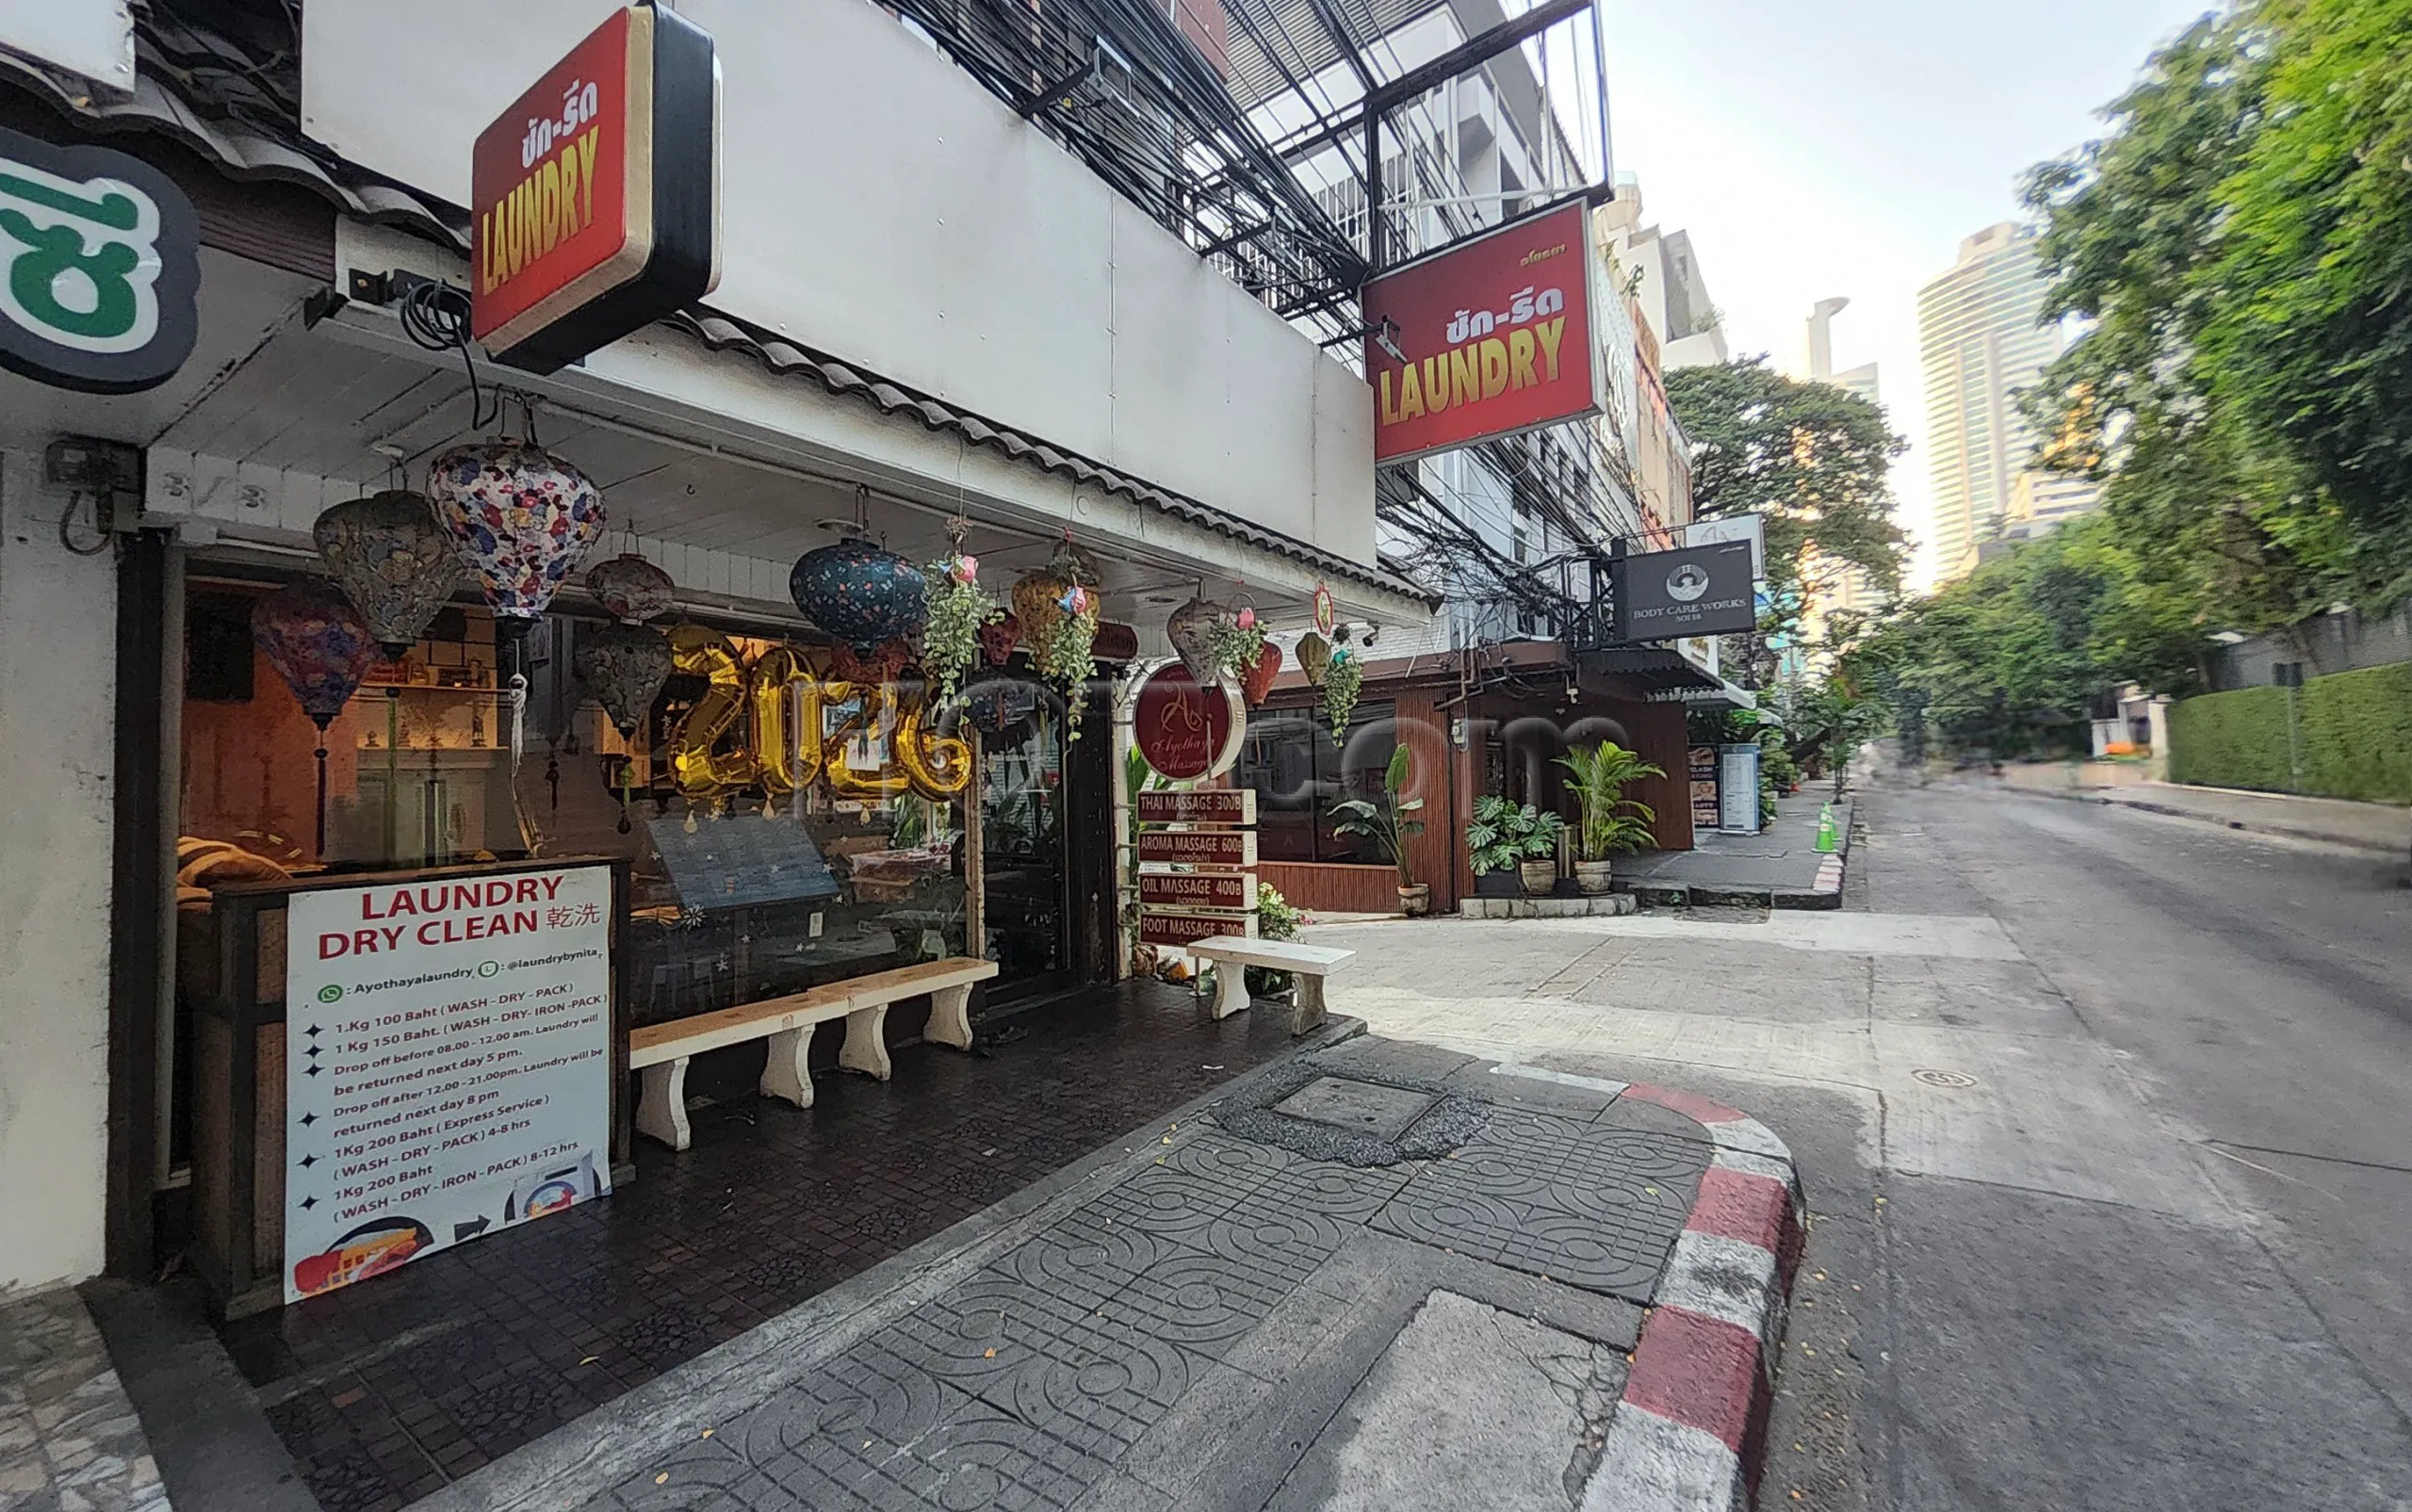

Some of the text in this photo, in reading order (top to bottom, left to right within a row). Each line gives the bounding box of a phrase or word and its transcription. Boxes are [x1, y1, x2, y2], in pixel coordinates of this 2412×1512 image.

[522, 78, 597, 169] ซัก-รีด
[482, 124, 599, 297] LAUNDRY
[1446, 285, 1564, 345] ซัก-รีด
[1379, 316, 1566, 427] LAUNDRY
[1634, 598, 1747, 620] BODY CARE WORKS
[668, 623, 973, 801] 2026
[1140, 795, 1164, 811] THAI
[1165, 795, 1213, 811] MASSAGE
[1141, 836, 1173, 851] AROMA
[1175, 837, 1217, 852] MASSAGE
[362, 875, 564, 920] LAUNDRY
[1142, 878, 1159, 893] OIL
[1161, 879, 1212, 894] MASSAGE
[318, 902, 601, 960] DRY CLEAN 乾洗
[1142, 918, 1168, 934] FOOT
[1169, 919, 1215, 936] MASSAGE
[348, 1041, 368, 1053] Kg
[373, 1034, 400, 1048] 150
[449, 1016, 490, 1032] WASH
[535, 1002, 565, 1016] IRON
[375, 1014, 401, 1027] 100
[405, 1007, 437, 1022] Baht
[448, 999, 488, 1013] WASH
[498, 991, 526, 1004] DRY
[535, 984, 567, 998] PACK
[334, 1063, 368, 1076] Drop
[372, 1056, 391, 1068] off
[393, 1049, 434, 1064] before
[436, 1040, 469, 1054] 08.00
[479, 1032, 510, 1045] 12.00
[535, 1019, 579, 1034] Laundry
[581, 1013, 598, 1024] will
[334, 1084, 354, 1096] be
[358, 1068, 423, 1091] returned
[427, 1061, 457, 1076] next
[460, 1056, 484, 1068] day
[486, 1053, 494, 1063] 5
[334, 1103, 368, 1117] Drop
[371, 1096, 390, 1108] off
[392, 1091, 423, 1104] after
[426, 1081, 460, 1096] 12.00
[524, 1056, 568, 1073] Laundry
[570, 1049, 589, 1062] will
[591, 1048, 603, 1057] be
[334, 1090, 499, 1138] returned next day 8 pm
[367, 1135, 396, 1150] 200
[399, 1126, 433, 1143] Baht
[444, 1110, 495, 1130] Express
[497, 1097, 543, 1116] Service
[341, 1156, 389, 1178] WASH
[401, 1145, 432, 1162] DRY
[442, 1131, 479, 1150] PACK
[488, 1124, 509, 1136] 4-8
[511, 1118, 530, 1130] hrs
[341, 1196, 389, 1219] WASH
[400, 1184, 432, 1202] DRY
[442, 1171, 477, 1190] IRON
[487, 1157, 521, 1176] PACK
[530, 1146, 558, 1162] 8-12
[560, 1141, 579, 1153] hrs
[367, 1176, 396, 1192] 200
[399, 1165, 433, 1182] Baht
